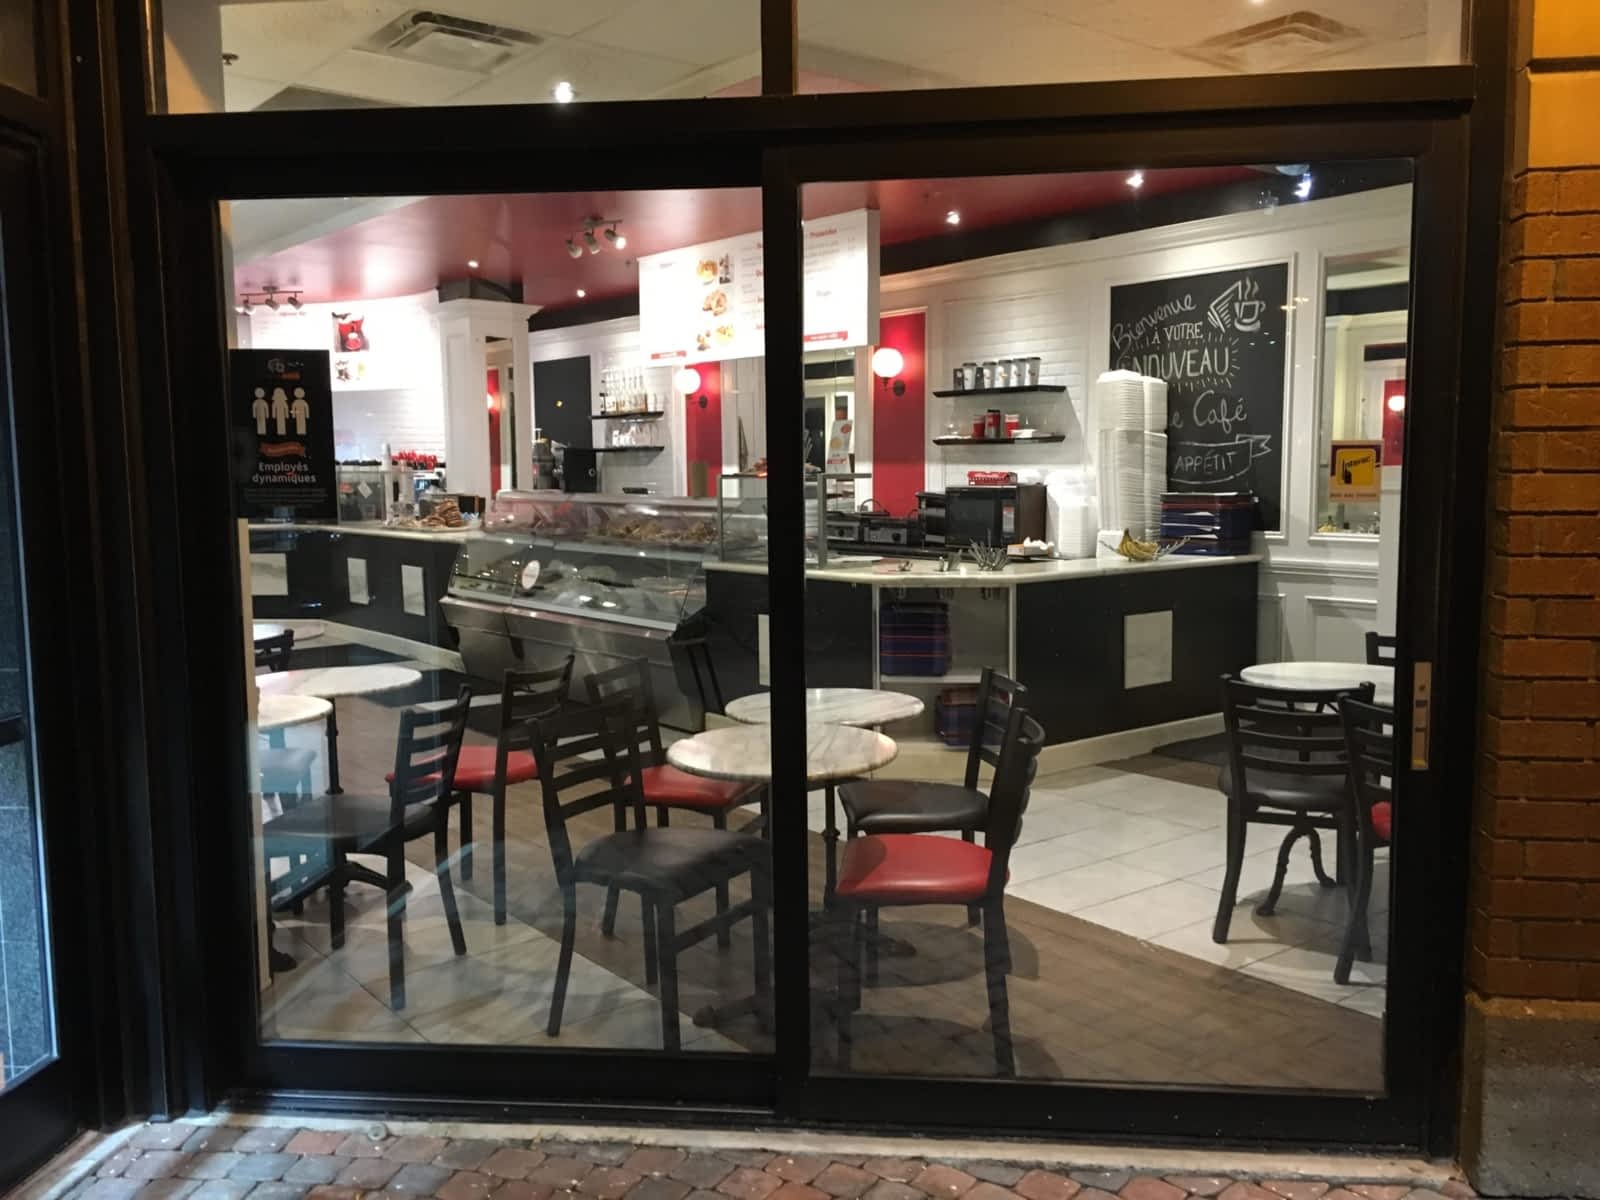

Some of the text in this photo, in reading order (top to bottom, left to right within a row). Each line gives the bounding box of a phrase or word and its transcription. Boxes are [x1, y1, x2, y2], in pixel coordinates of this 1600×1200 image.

[1112, 294, 1197, 350] Bienvenue
[1163, 322, 1204, 341] VOTRE
[1132, 347, 1230, 380] NOUVEAU
[1193, 390, 1248, 433] Café
[252, 473, 317, 485] dynamiques
[258, 461, 309, 474] Employés
